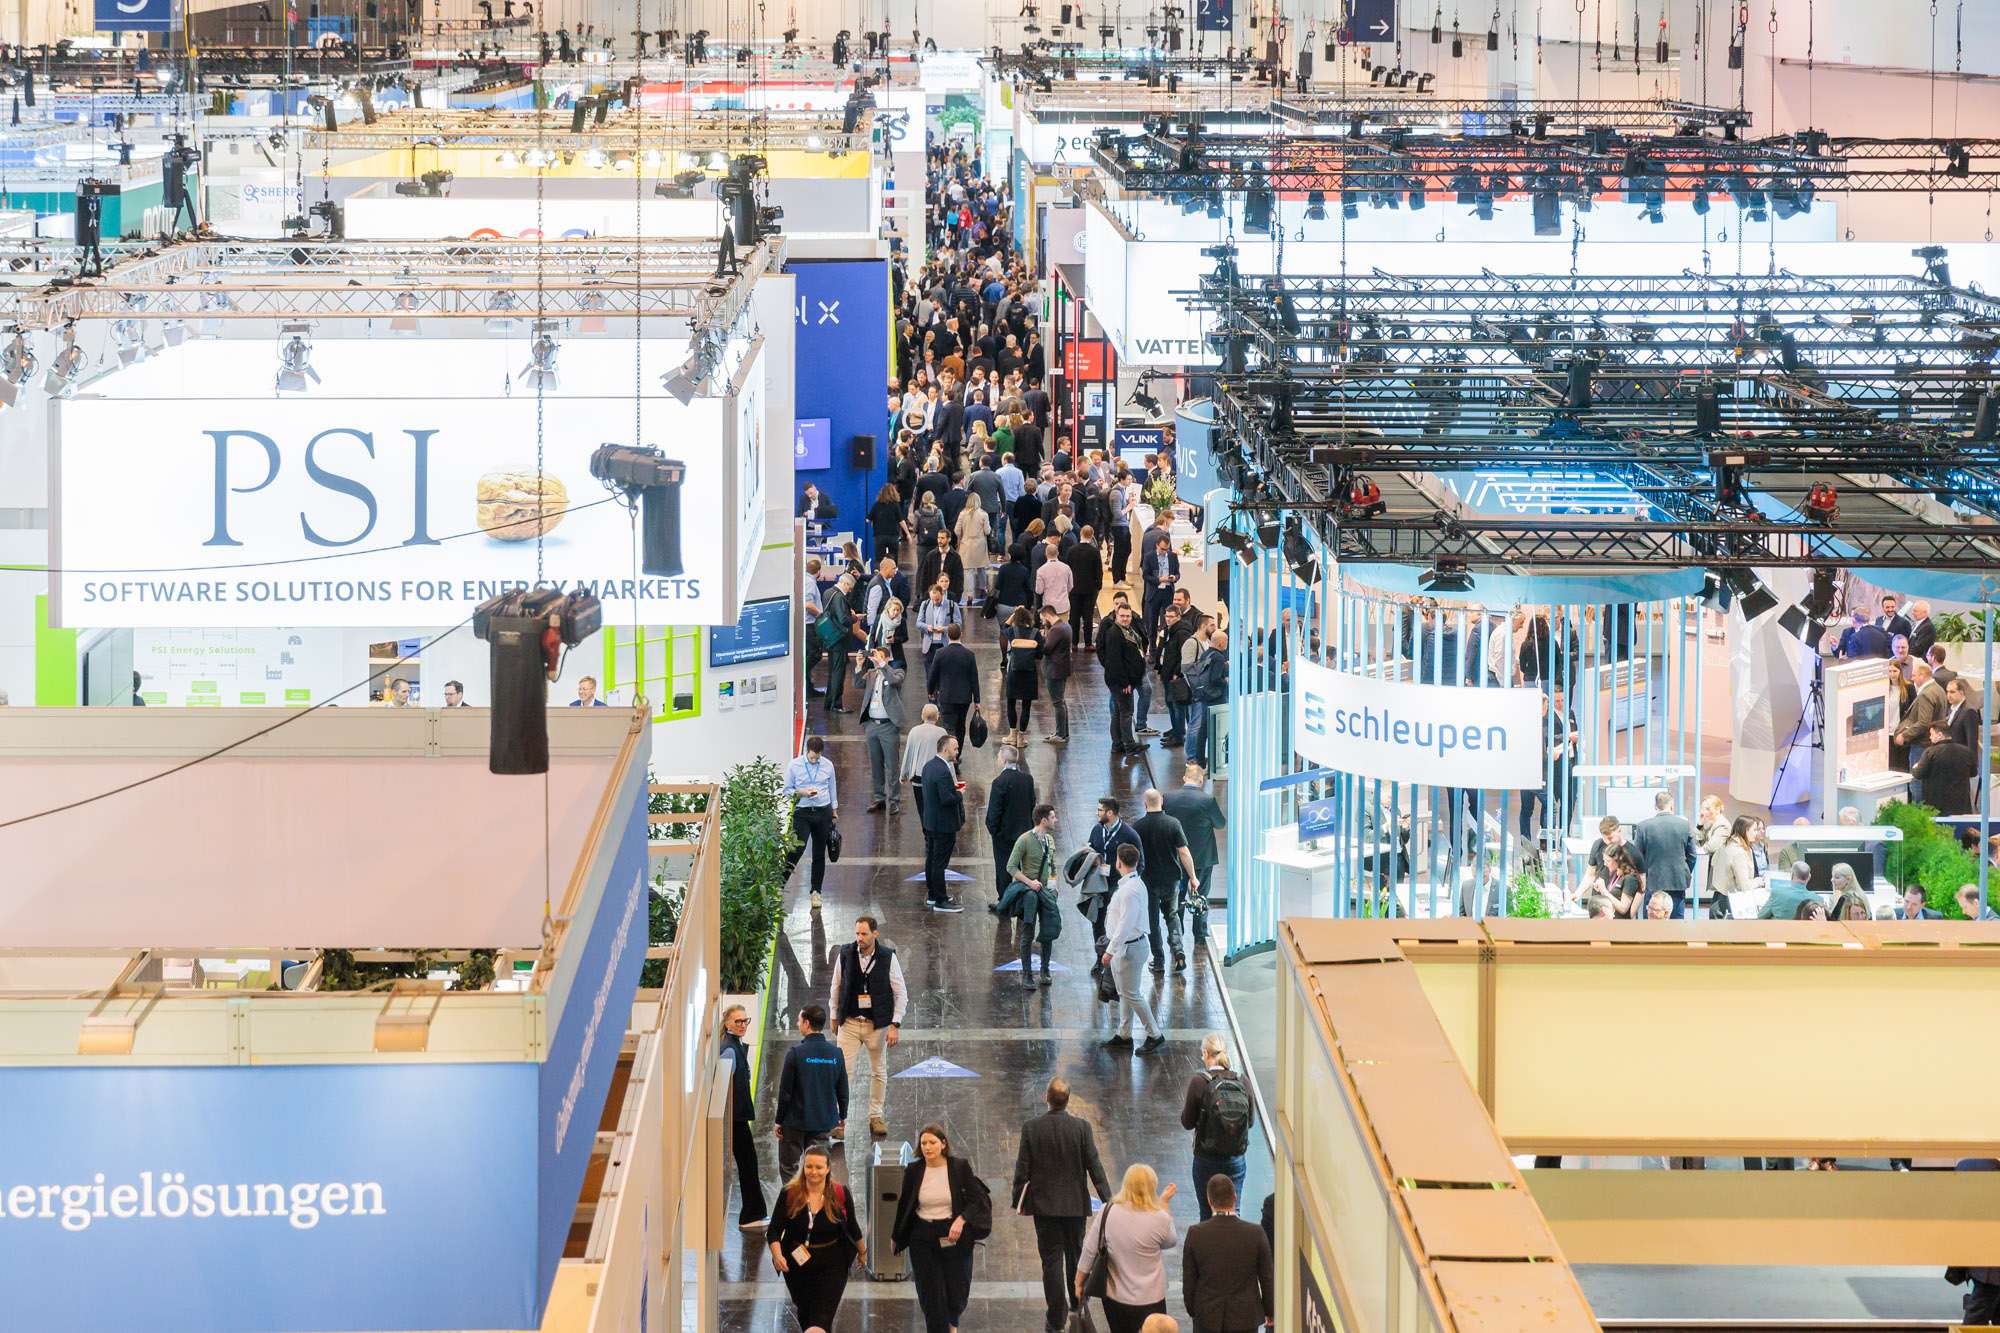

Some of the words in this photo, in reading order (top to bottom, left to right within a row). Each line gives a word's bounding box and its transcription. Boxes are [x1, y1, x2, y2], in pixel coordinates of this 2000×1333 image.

[1121, 434, 1158, 444] VLINK
[202, 428, 441, 547] PSI
[83, 580, 227, 602] SOFTWARE
[235, 579, 392, 602] SOLUTIONS
[401, 579, 453, 601] FOR
[576, 577, 701, 601] MARKETS
[171, 646, 205, 656] Energy
[208, 646, 256, 655] Solutions
[1335, 706, 1508, 758] schleupen
[0, 1171, 387, 1231] ergielösungen
